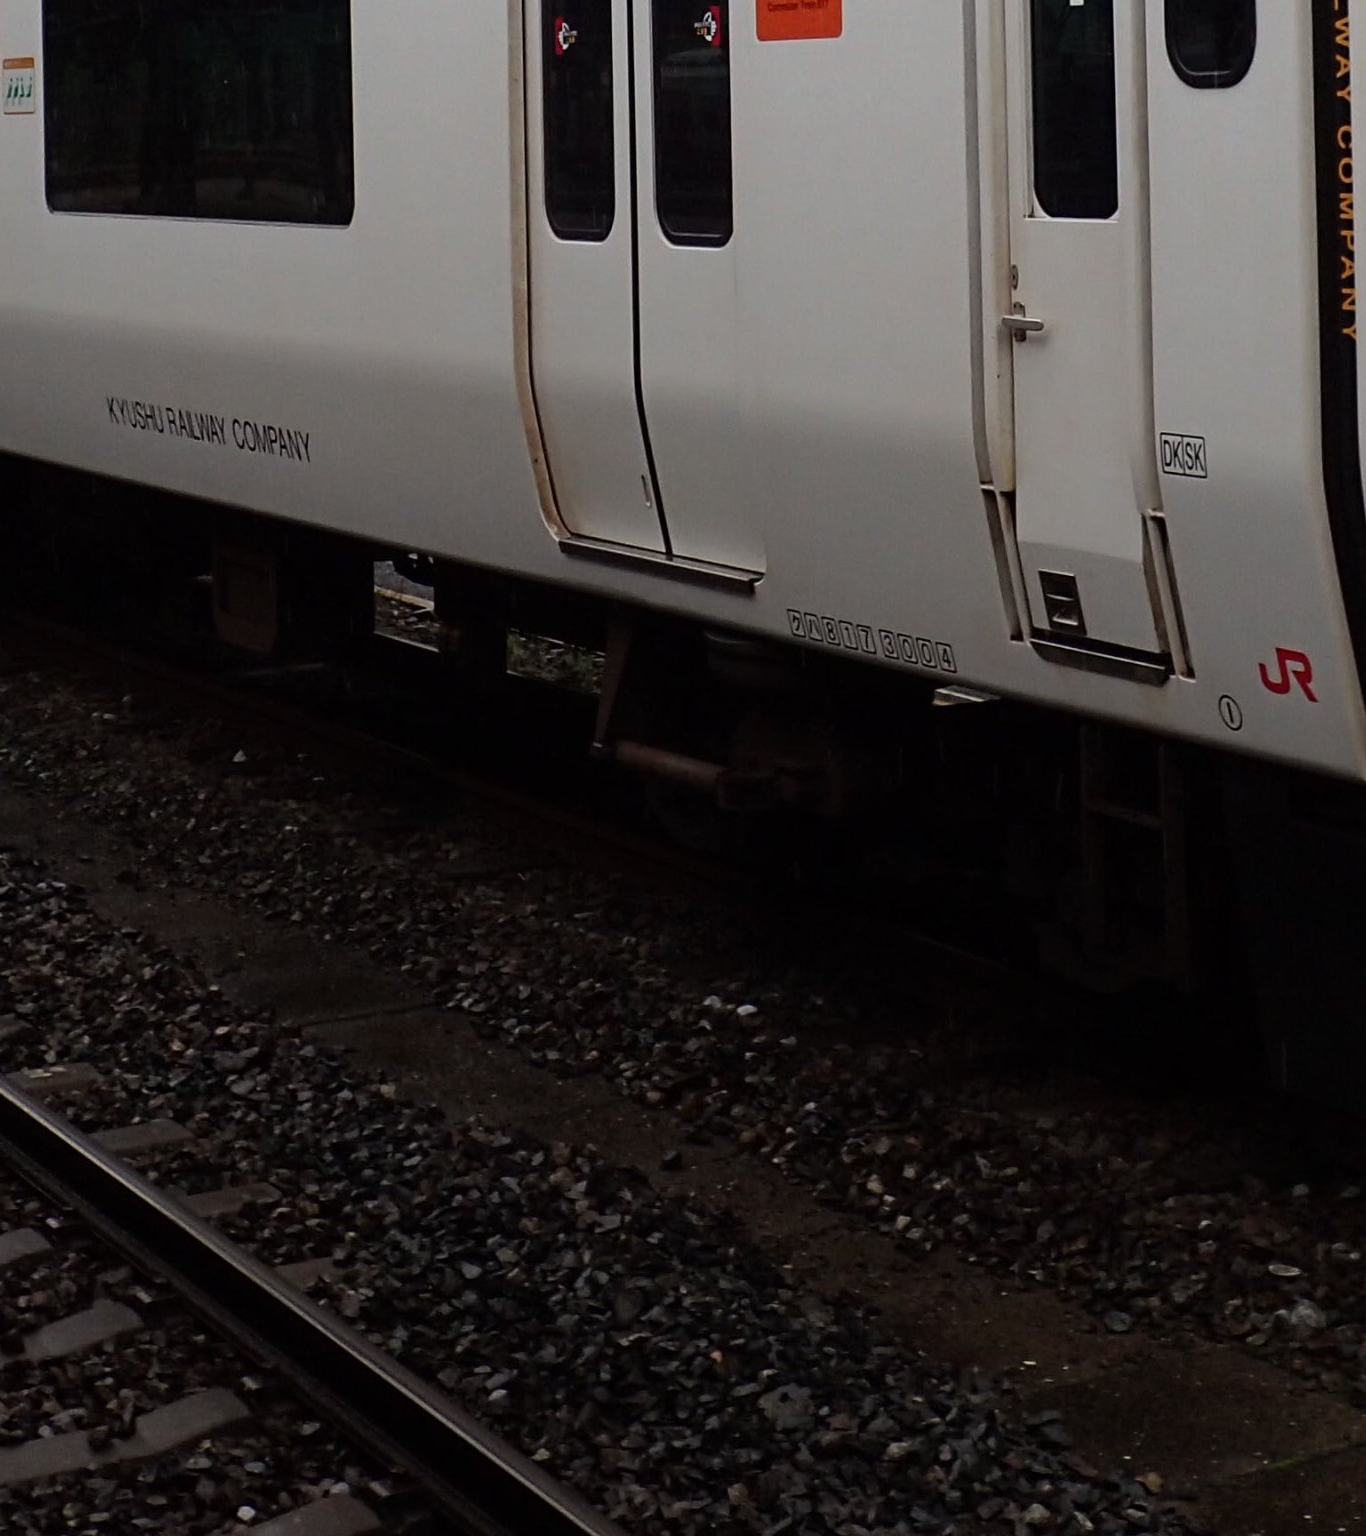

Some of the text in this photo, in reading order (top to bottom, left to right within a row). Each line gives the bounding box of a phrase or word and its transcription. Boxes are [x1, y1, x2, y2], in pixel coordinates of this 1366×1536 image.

[107, 396, 311, 463] KYUSHU RAILWAY COMPANY
[1258, 647, 1319, 703] JR
